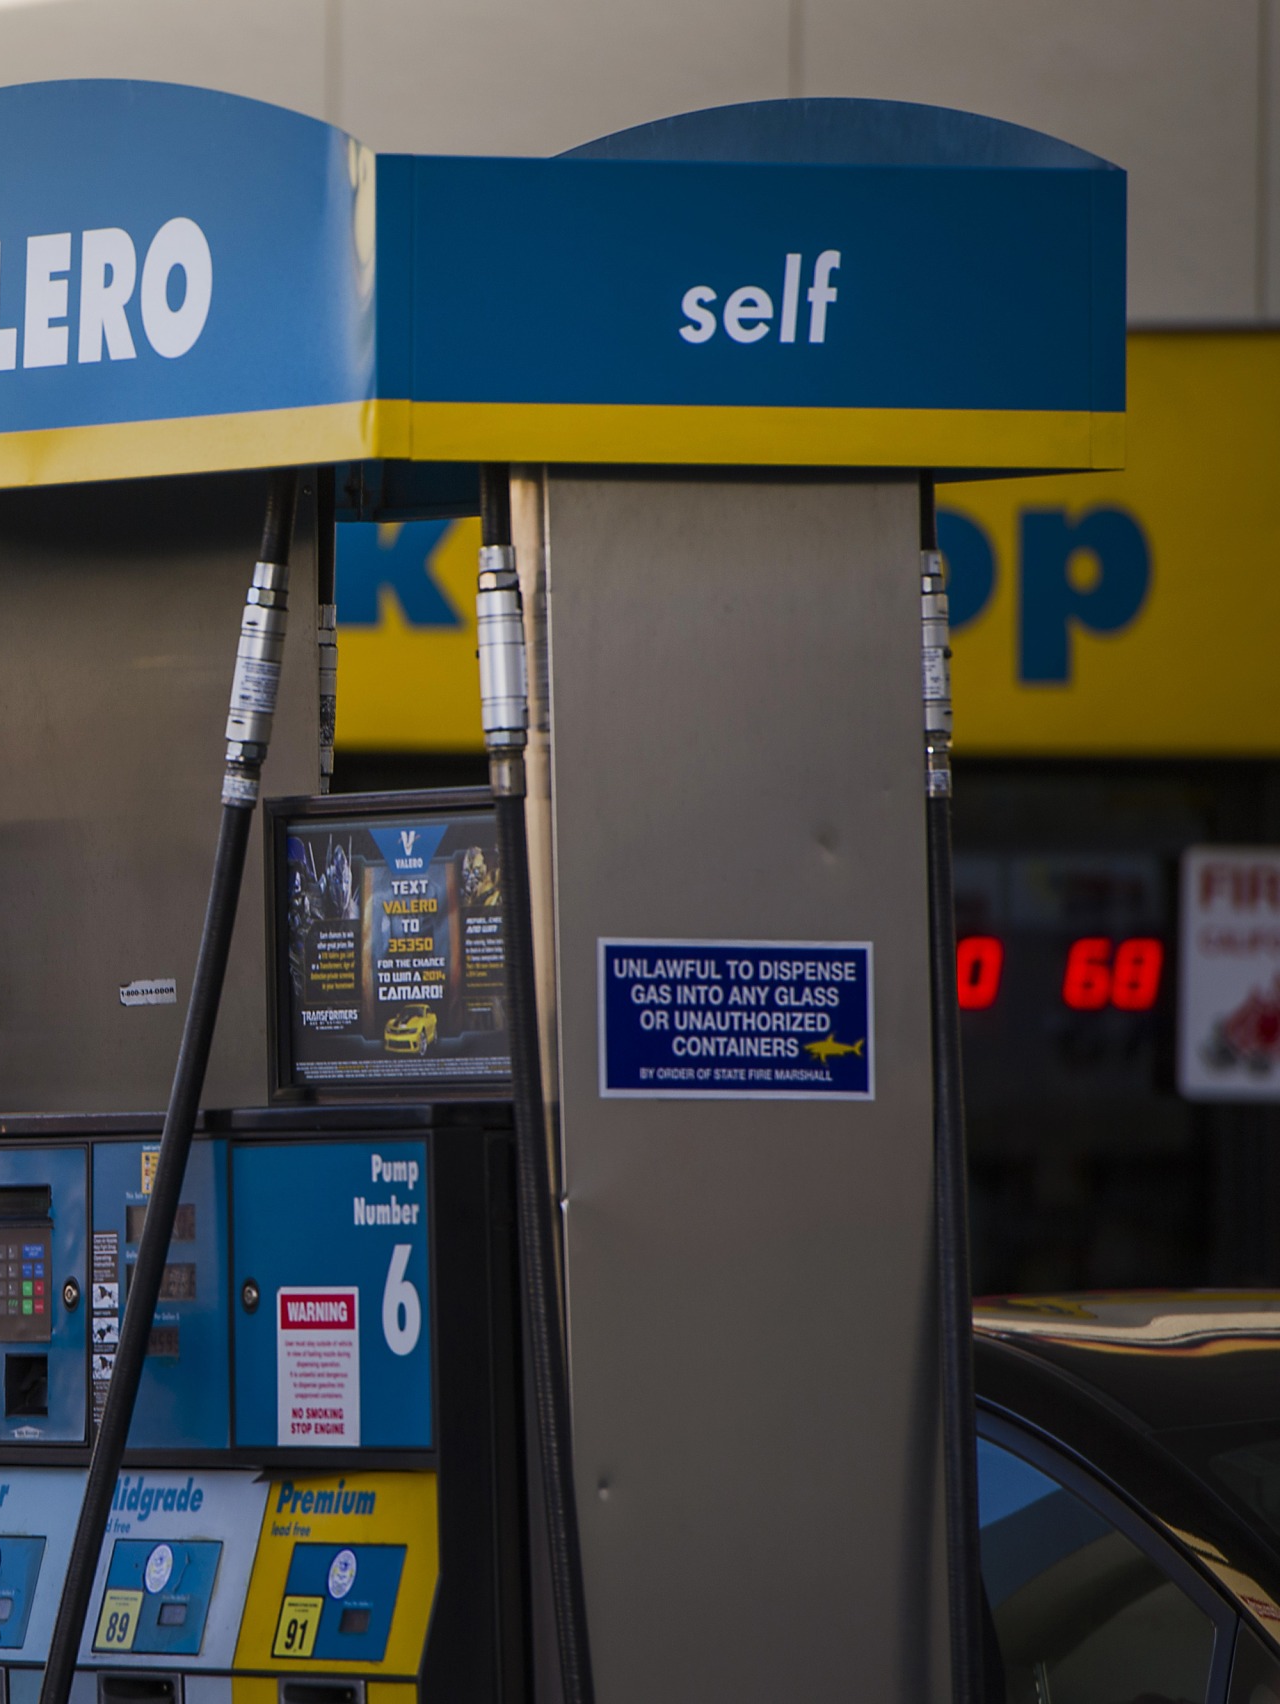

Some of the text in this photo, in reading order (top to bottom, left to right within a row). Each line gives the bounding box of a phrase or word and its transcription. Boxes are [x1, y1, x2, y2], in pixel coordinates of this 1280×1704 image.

[678, 249, 842, 344] self
[395, 858, 423, 869] VALERO
[392, 880, 428, 895] TEXT
[383, 899, 438, 914] VALERO
[401, 919, 419, 932] TO
[388, 938, 433, 952] 35350
[377, 957, 445, 969] FOR THE CHANCE
[613, 959, 856, 981] UNLAWFUL TO DISPENSE
[378, 970, 446, 983] TO WIN A 2014
[378, 985, 443, 1000] CAMARO!
[631, 984, 839, 1007] GAS INTO ANY GLASS
[302, 1009, 358, 1025] TRANSFORMERS
[640, 1010, 830, 1032] OR UNAUTHORIZED
[672, 1036, 799, 1057] CONTAINERS
[640, 1068, 832, 1081] BY ORDER OF STATE FIRE MARSHALL
[371, 1154, 419, 1190] Pump
[354, 1195, 419, 1225] Number
[382, 1244, 421, 1356] 6
[287, 1301, 348, 1322] WARNING
[292, 1407, 344, 1420] NO SMOKING
[291, 1422, 345, 1435] STOP ENGINE
[276, 1478, 376, 1515] Premium
[113, 1518, 131, 1534] free
[271, 1521, 311, 1536] lead free
[106, 1612, 130, 1643] 89
[284, 1618, 308, 1650] 91
